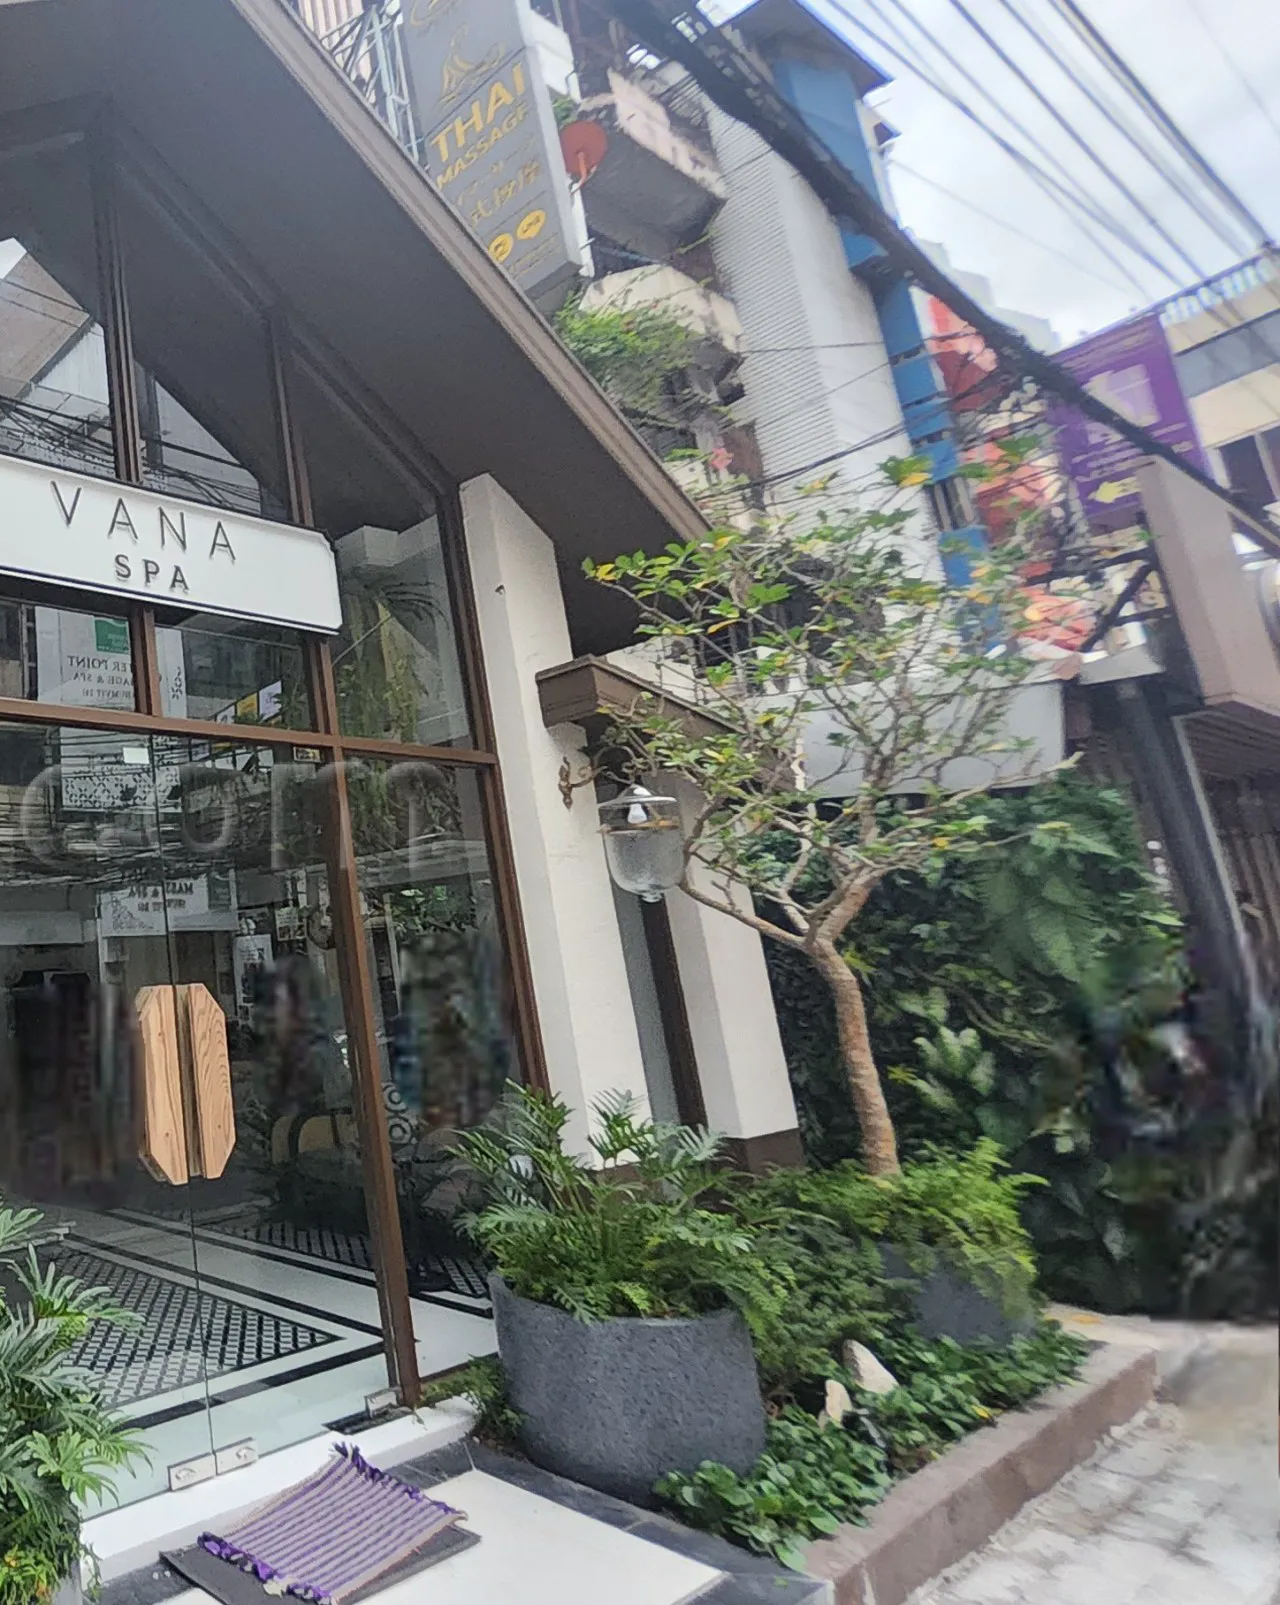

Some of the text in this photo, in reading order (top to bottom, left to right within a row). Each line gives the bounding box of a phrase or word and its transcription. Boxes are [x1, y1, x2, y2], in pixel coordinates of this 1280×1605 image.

[430, 61, 526, 163] THAI
[436, 101, 528, 192] MASSAGE
[50, 480, 236, 562] VANA
[114, 553, 190, 593] SPA
